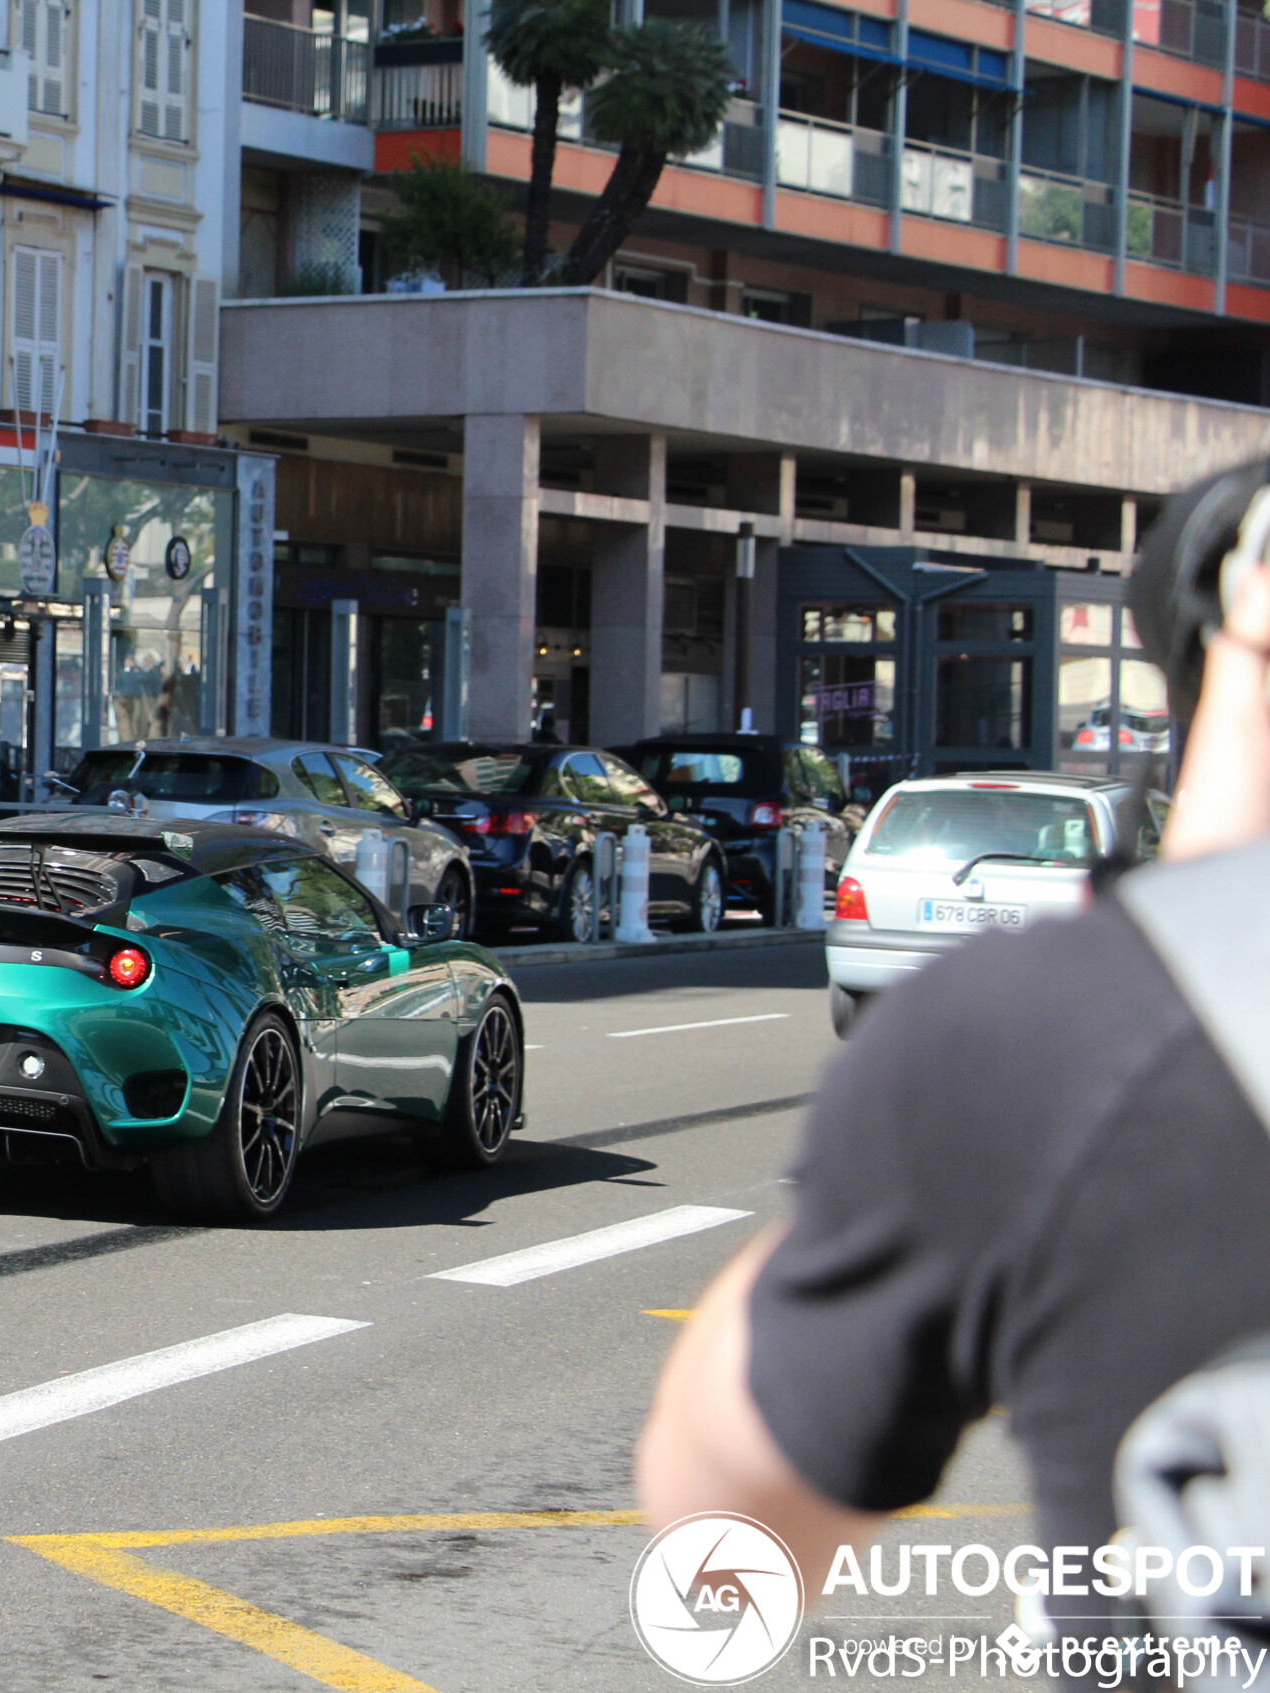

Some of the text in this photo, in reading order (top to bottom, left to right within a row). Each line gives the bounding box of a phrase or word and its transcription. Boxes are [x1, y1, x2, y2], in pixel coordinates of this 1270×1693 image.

[936, 905, 1021, 925] 678 CBR 06
